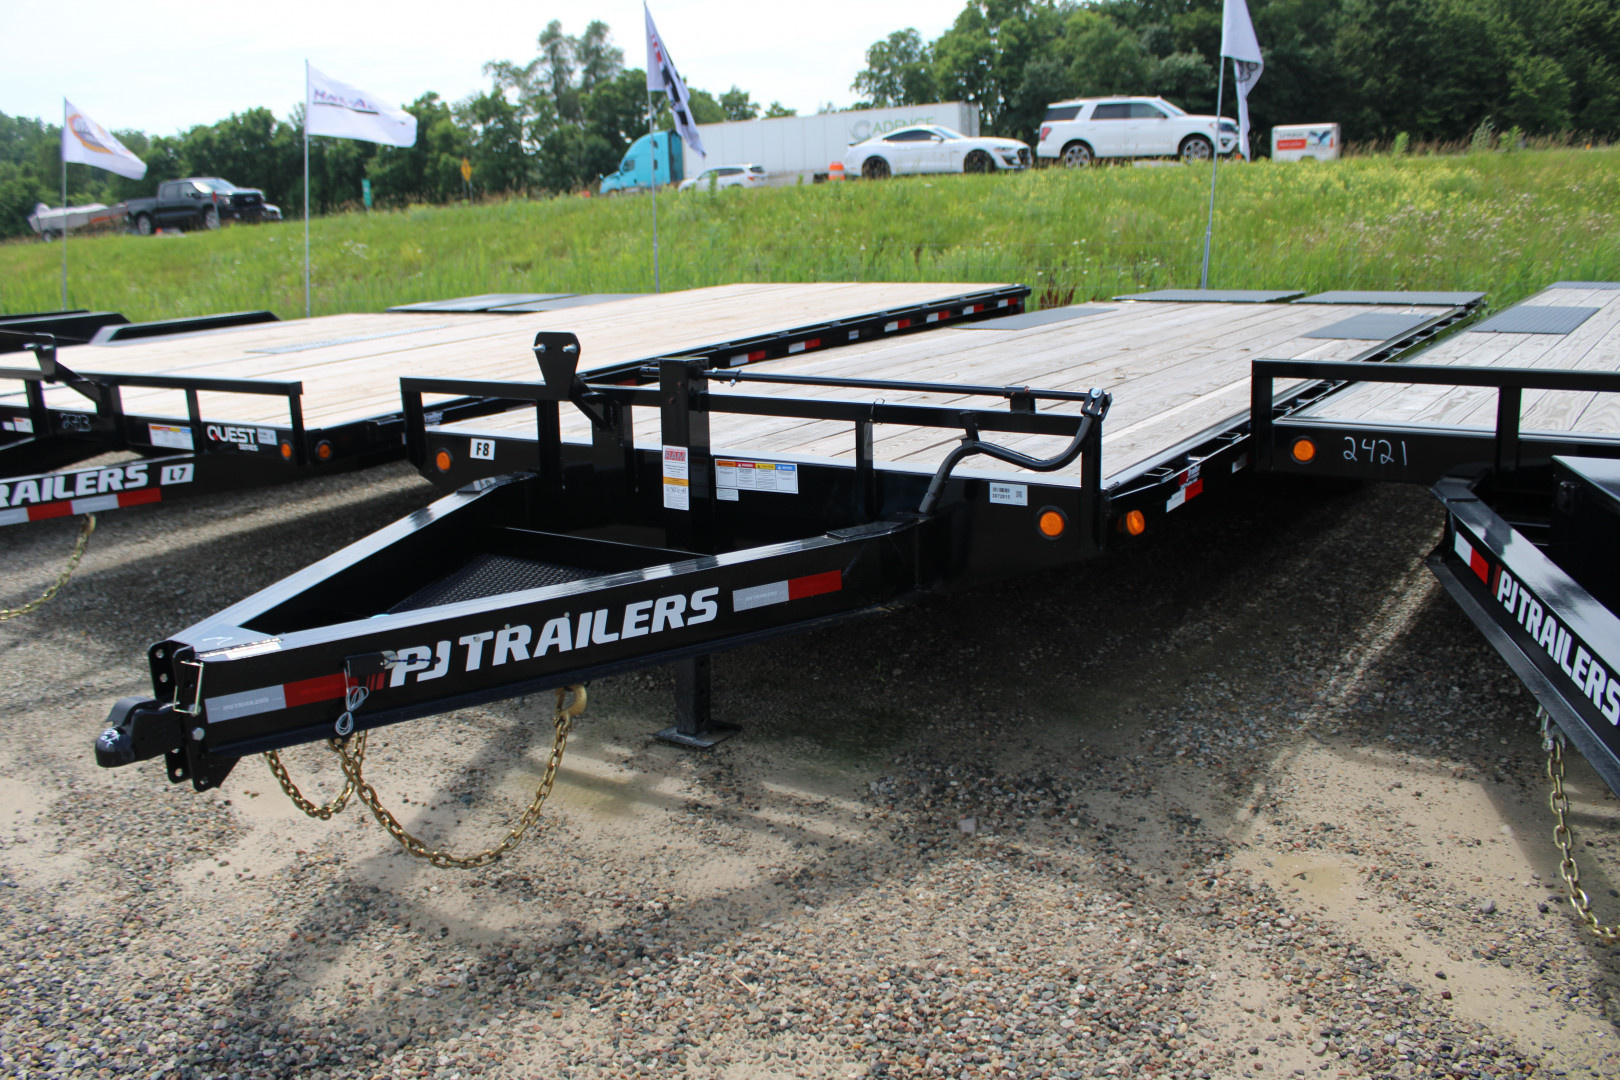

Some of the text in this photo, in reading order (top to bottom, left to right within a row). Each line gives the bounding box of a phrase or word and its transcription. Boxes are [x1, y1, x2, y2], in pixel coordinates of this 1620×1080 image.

[207, 425, 256, 444] QUEST
[476, 442, 490, 457] F8
[1343, 436, 1408, 467] 2421
[390, 587, 719, 688] PJ TRAILERS
[1497, 570, 1620, 726] PJ TRAILERS
